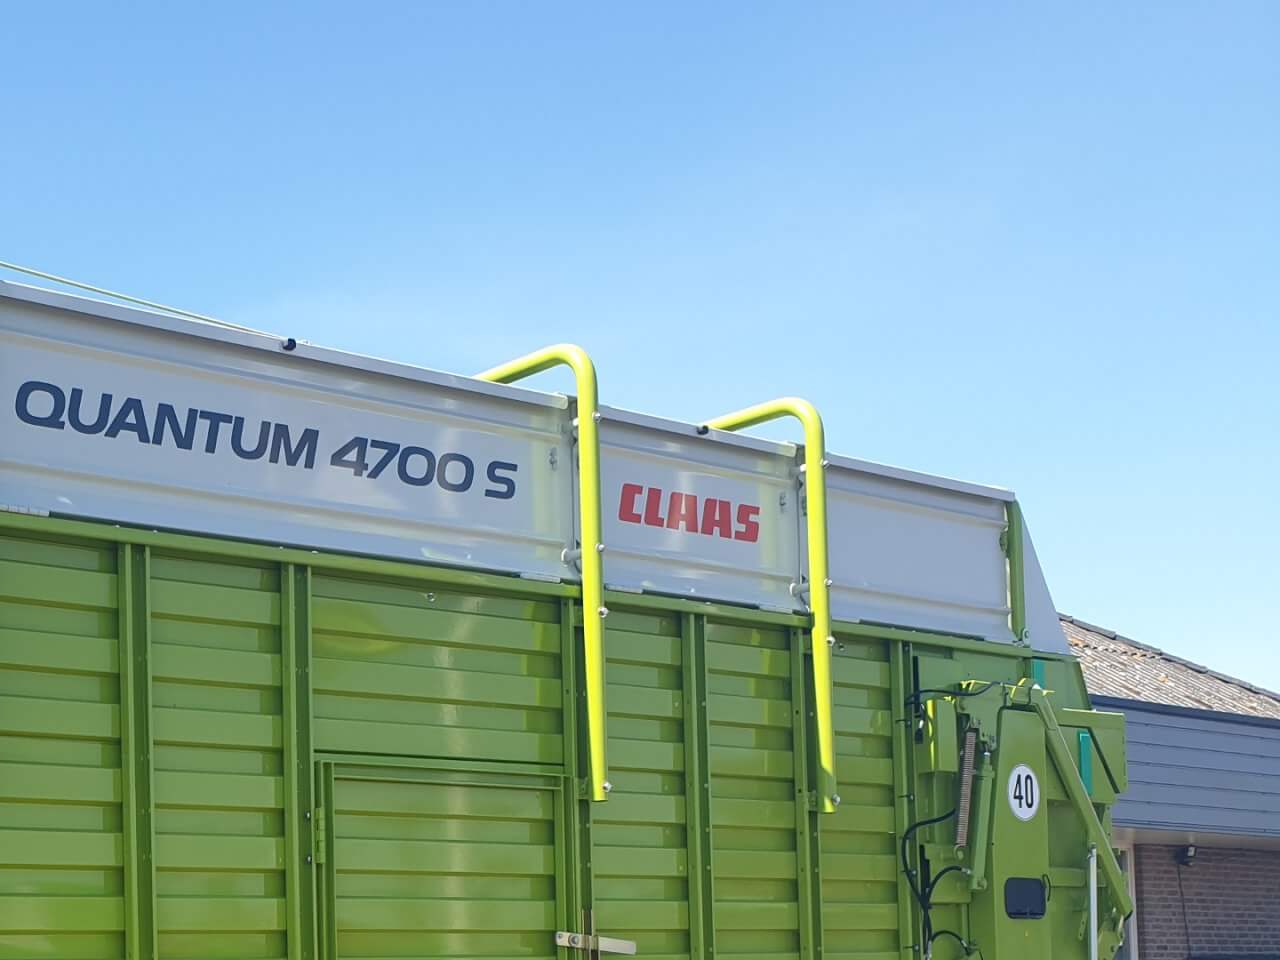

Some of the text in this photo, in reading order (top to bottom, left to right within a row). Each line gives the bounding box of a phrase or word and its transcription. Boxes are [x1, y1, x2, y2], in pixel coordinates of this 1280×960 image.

[15, 381, 518, 499] QUANTUM 4700 S
[618, 483, 761, 543] CLAAS
[1014, 774, 1034, 808] 40
